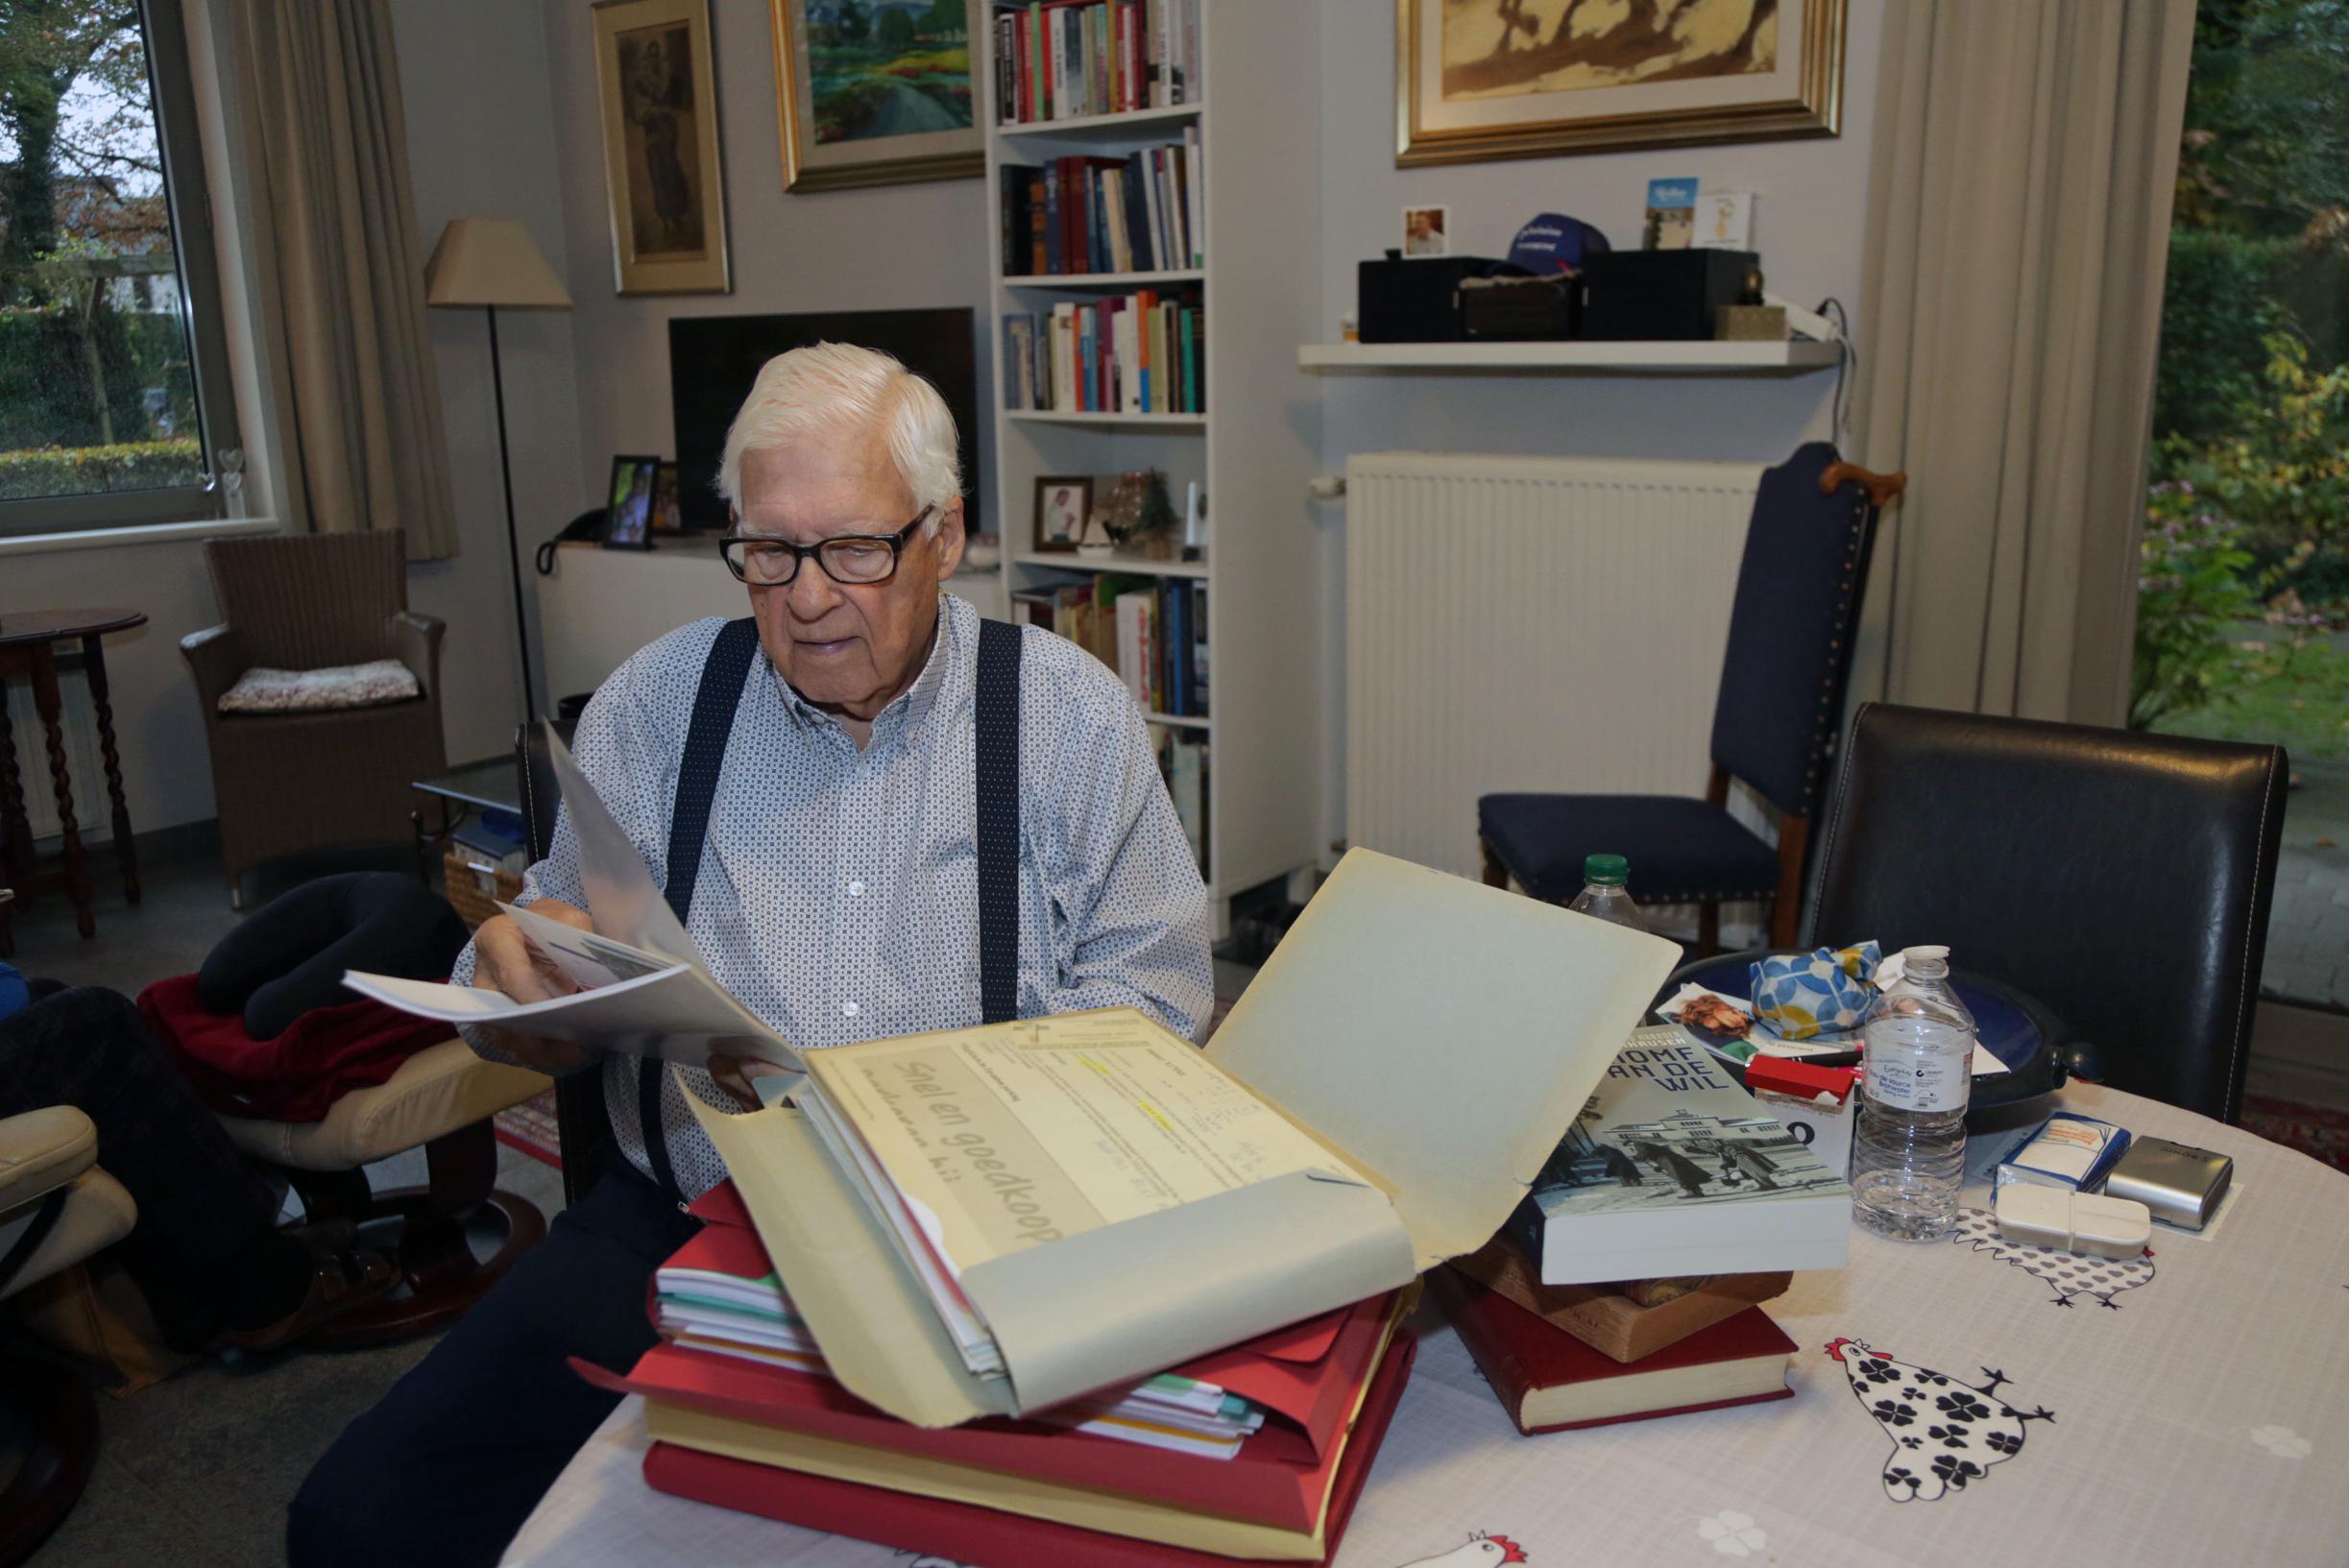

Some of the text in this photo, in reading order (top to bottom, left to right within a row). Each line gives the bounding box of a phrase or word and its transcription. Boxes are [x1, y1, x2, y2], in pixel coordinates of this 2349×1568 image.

[1616, 1047, 1694, 1063] IOMF
[1608, 1061, 1713, 1078] AN DE
[892, 1061, 958, 1098] Snel
[1654, 1075, 1729, 1092] WIL
[929, 1103, 971, 1125] en
[940, 1133, 1064, 1242] goedkoop
